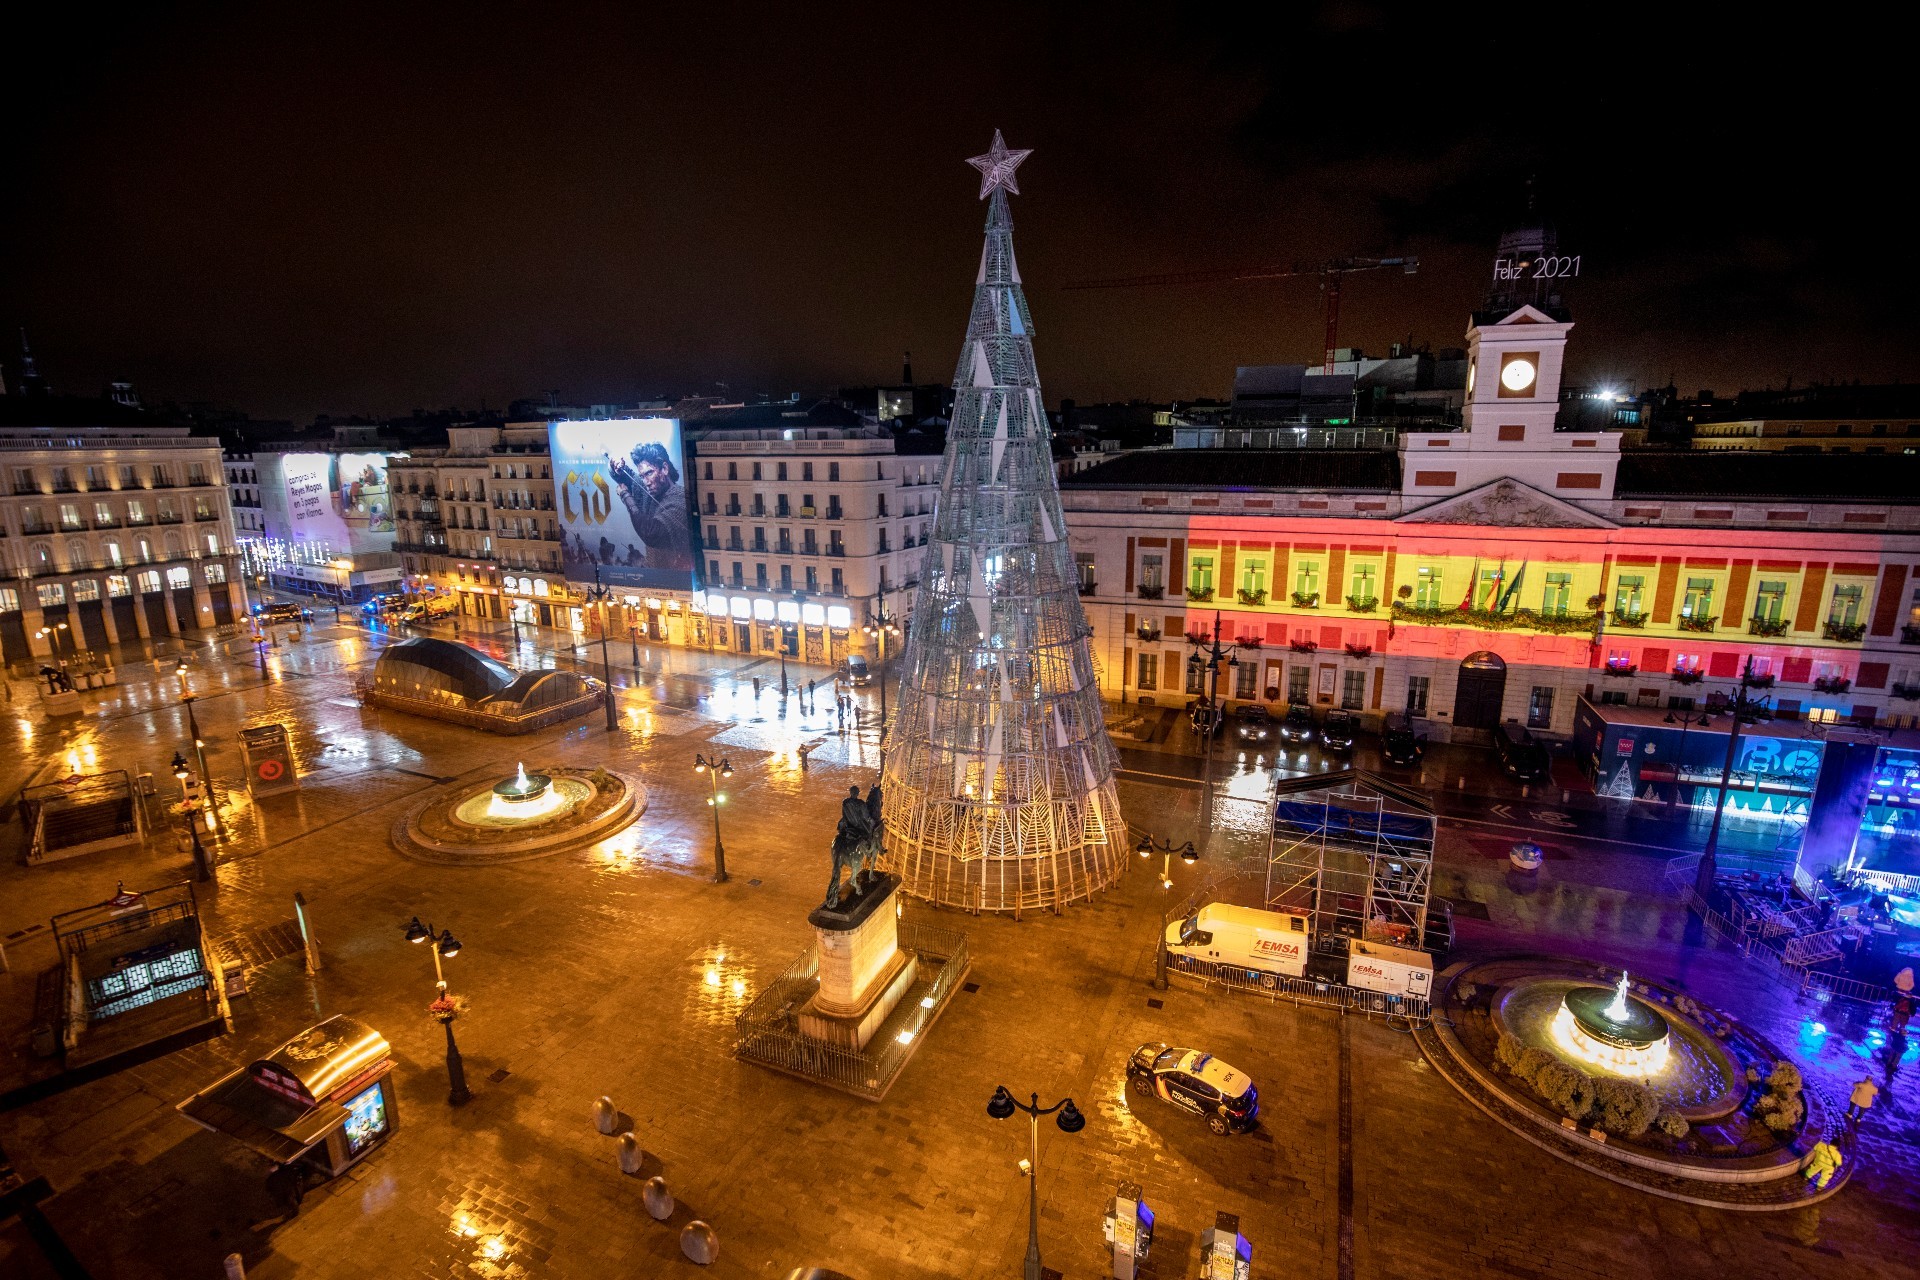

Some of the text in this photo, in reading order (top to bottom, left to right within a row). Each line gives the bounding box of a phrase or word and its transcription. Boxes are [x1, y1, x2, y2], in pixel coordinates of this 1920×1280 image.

[1493, 255, 1581, 280] Feliz 2021
[291, 482, 323, 497] Reyes Magos
[305, 496, 319, 508] pagos
[1261, 940, 1299, 955] EMSA
[1357, 965, 1383, 976] EMSA
